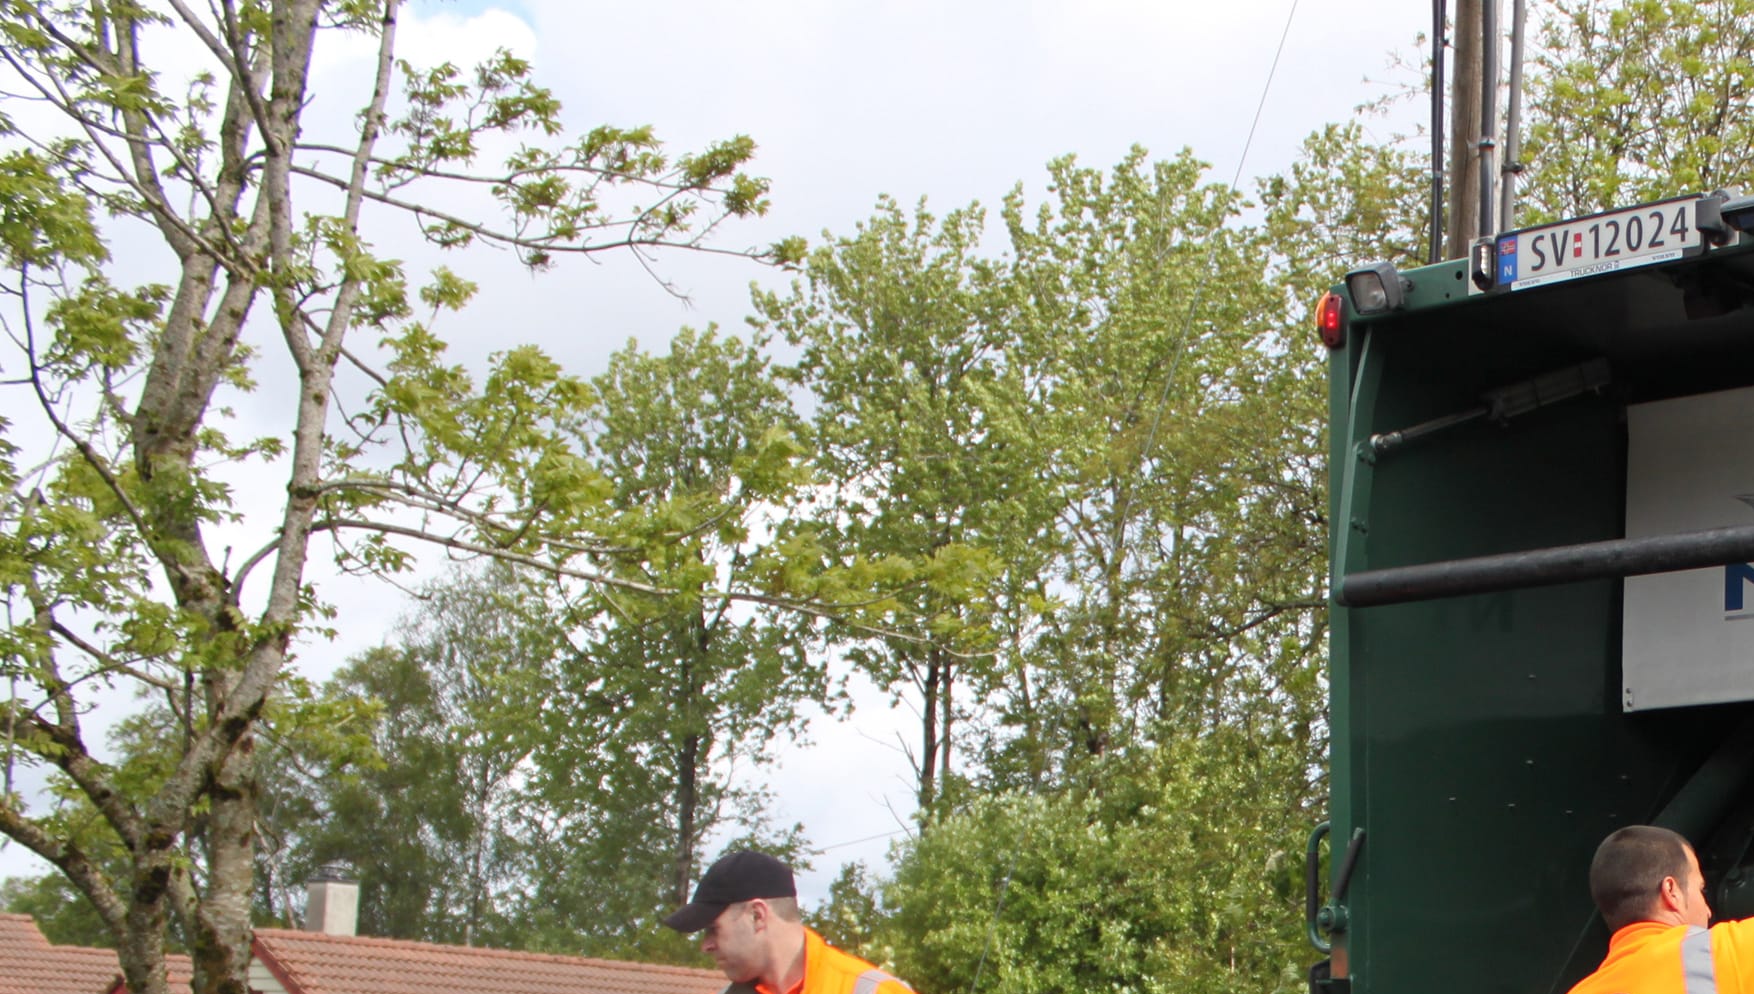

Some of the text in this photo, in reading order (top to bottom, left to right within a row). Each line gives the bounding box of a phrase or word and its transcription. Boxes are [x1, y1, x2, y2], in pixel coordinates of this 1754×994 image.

[1531, 206, 1689, 272] SV 12024
[1503, 264, 1513, 278] N
